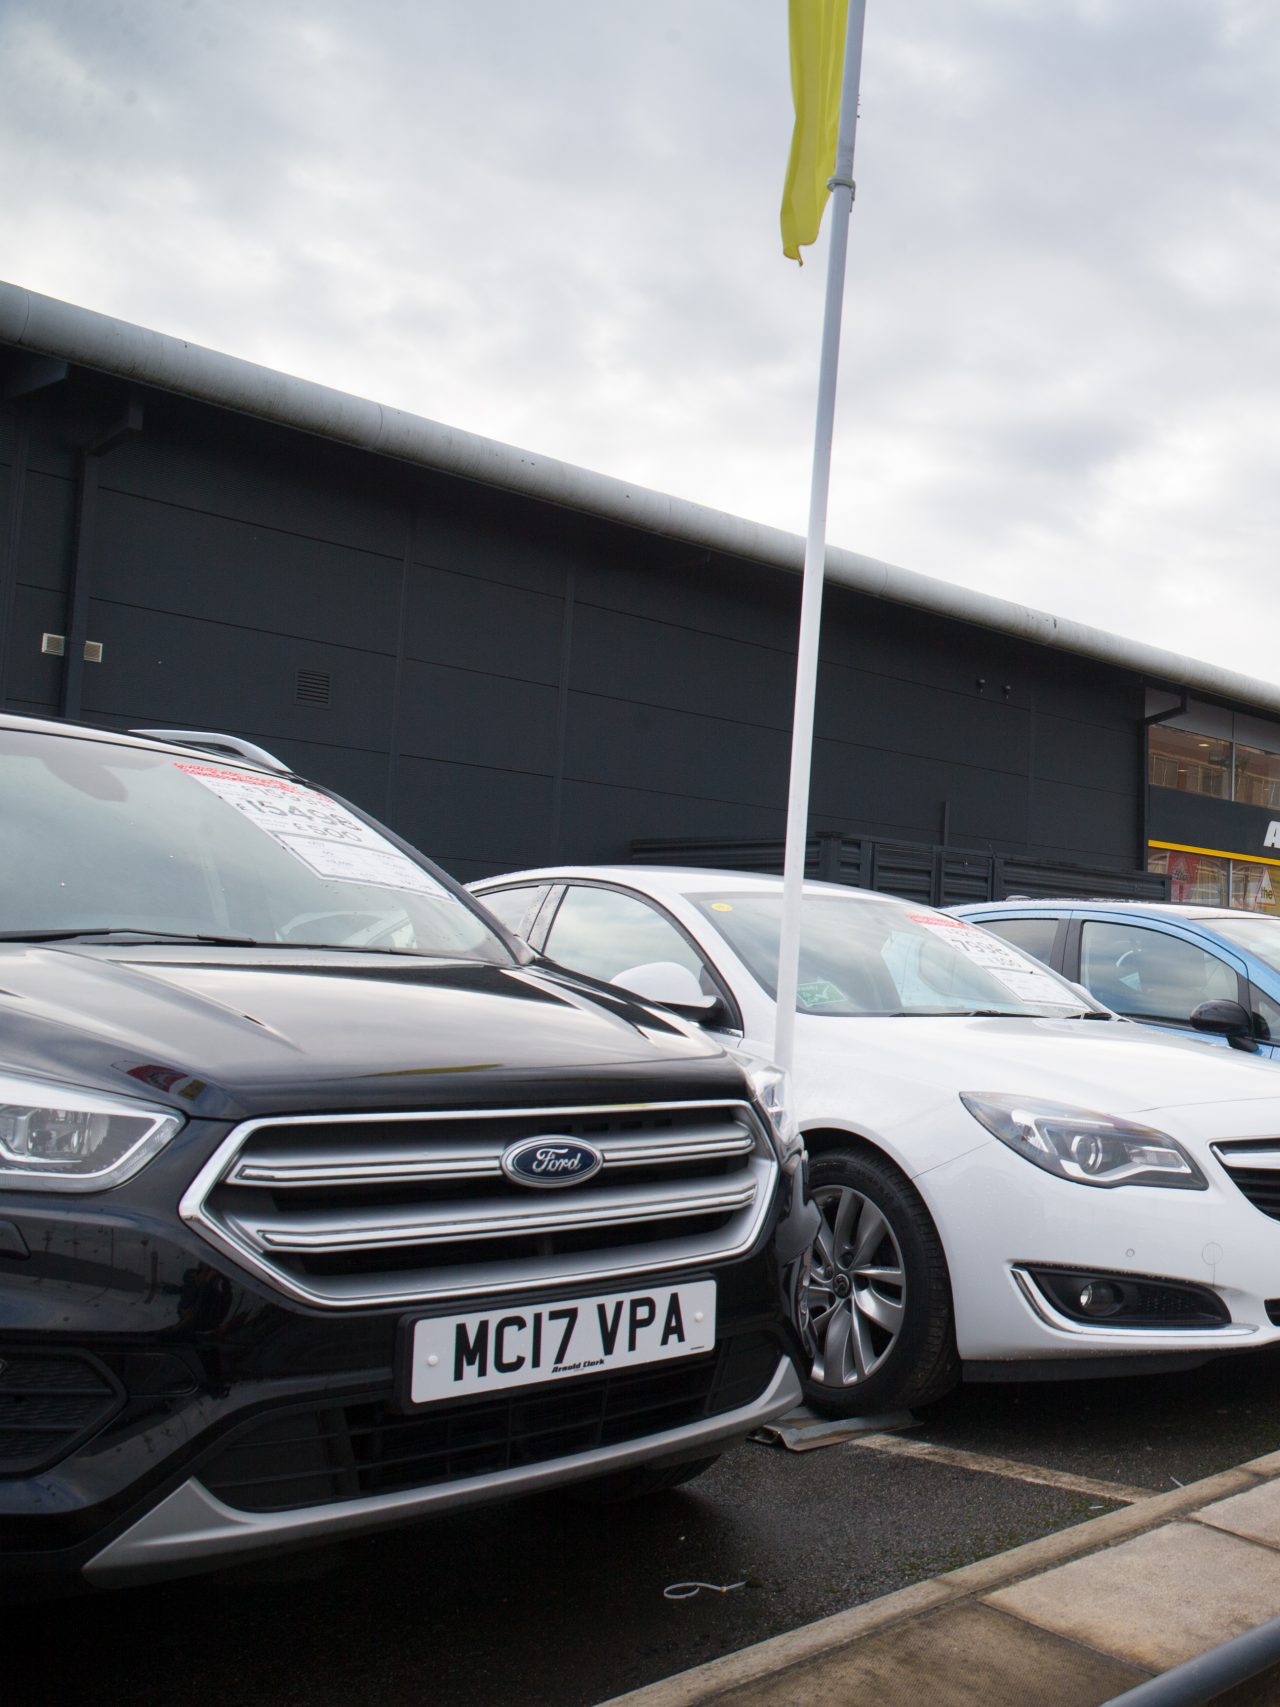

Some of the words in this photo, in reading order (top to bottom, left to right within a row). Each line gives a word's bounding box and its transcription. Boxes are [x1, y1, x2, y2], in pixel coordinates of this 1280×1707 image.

[532, 1148, 582, 1173] Ford
[453, 1307, 578, 1382] MC17
[597, 1292, 686, 1356] VPA
[551, 1362, 582, 1374] Arnold
[583, 1358, 605, 1369] Clark
